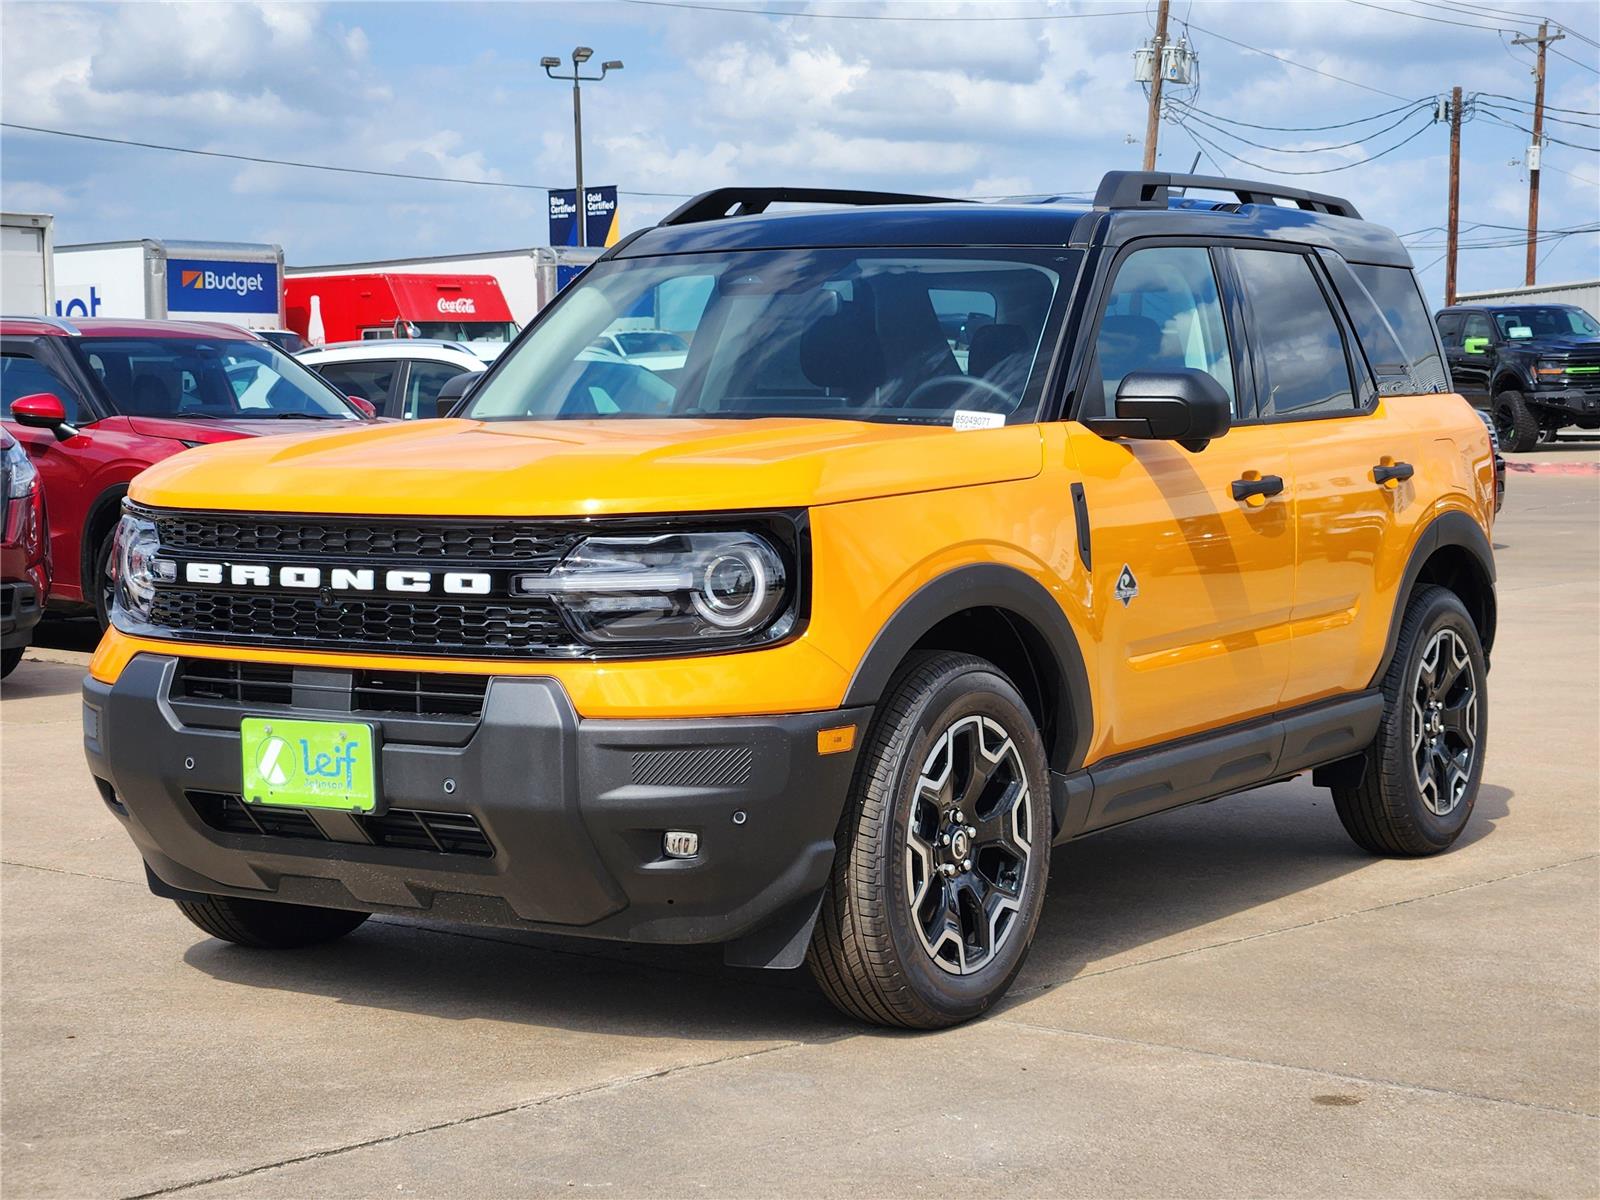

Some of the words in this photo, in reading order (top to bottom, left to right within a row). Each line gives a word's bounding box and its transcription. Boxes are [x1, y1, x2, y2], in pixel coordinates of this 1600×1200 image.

[550, 196, 565, 205] Blue
[587, 193, 602, 202] Gold
[550, 204, 576, 214] Certified
[587, 200, 614, 211] Certified
[205, 271, 263, 296] Budget
[186, 562, 491, 594] BRONCO
[300, 738, 359, 791] leif
